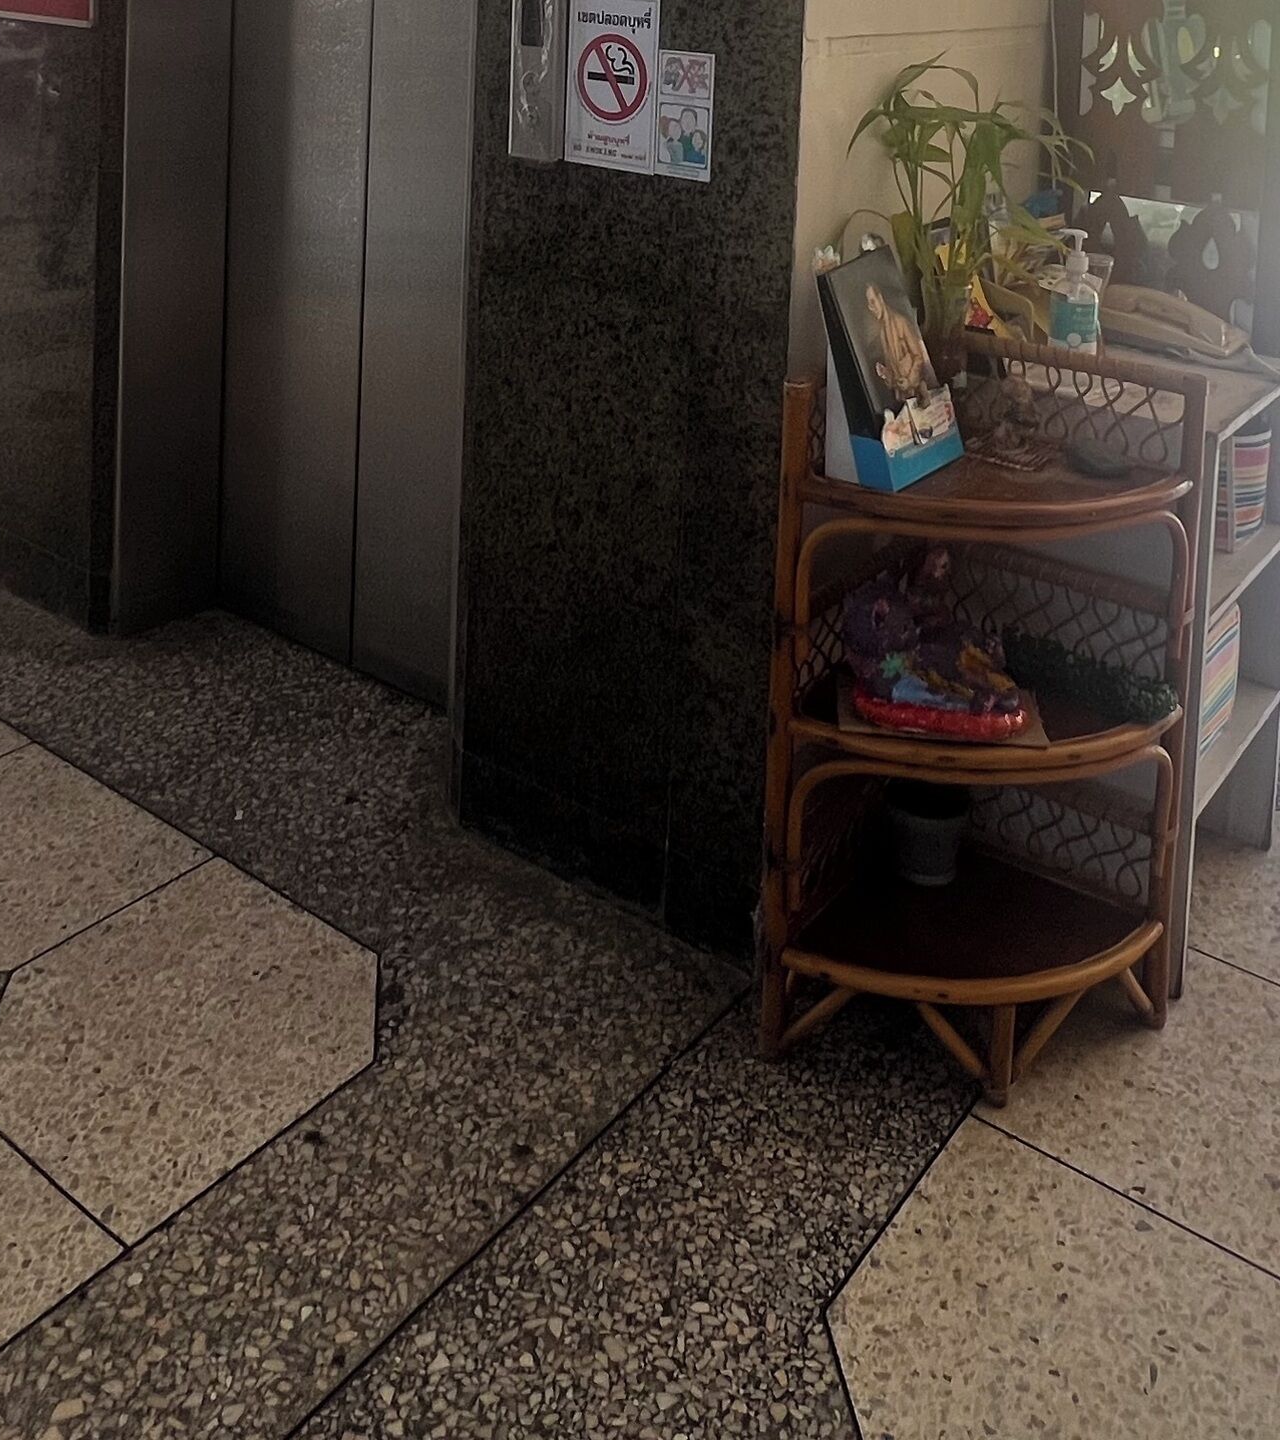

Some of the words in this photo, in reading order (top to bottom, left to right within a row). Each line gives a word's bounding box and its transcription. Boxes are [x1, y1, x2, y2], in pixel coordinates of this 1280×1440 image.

[577, 7, 652, 35] เขตปลอดบุหรี่
